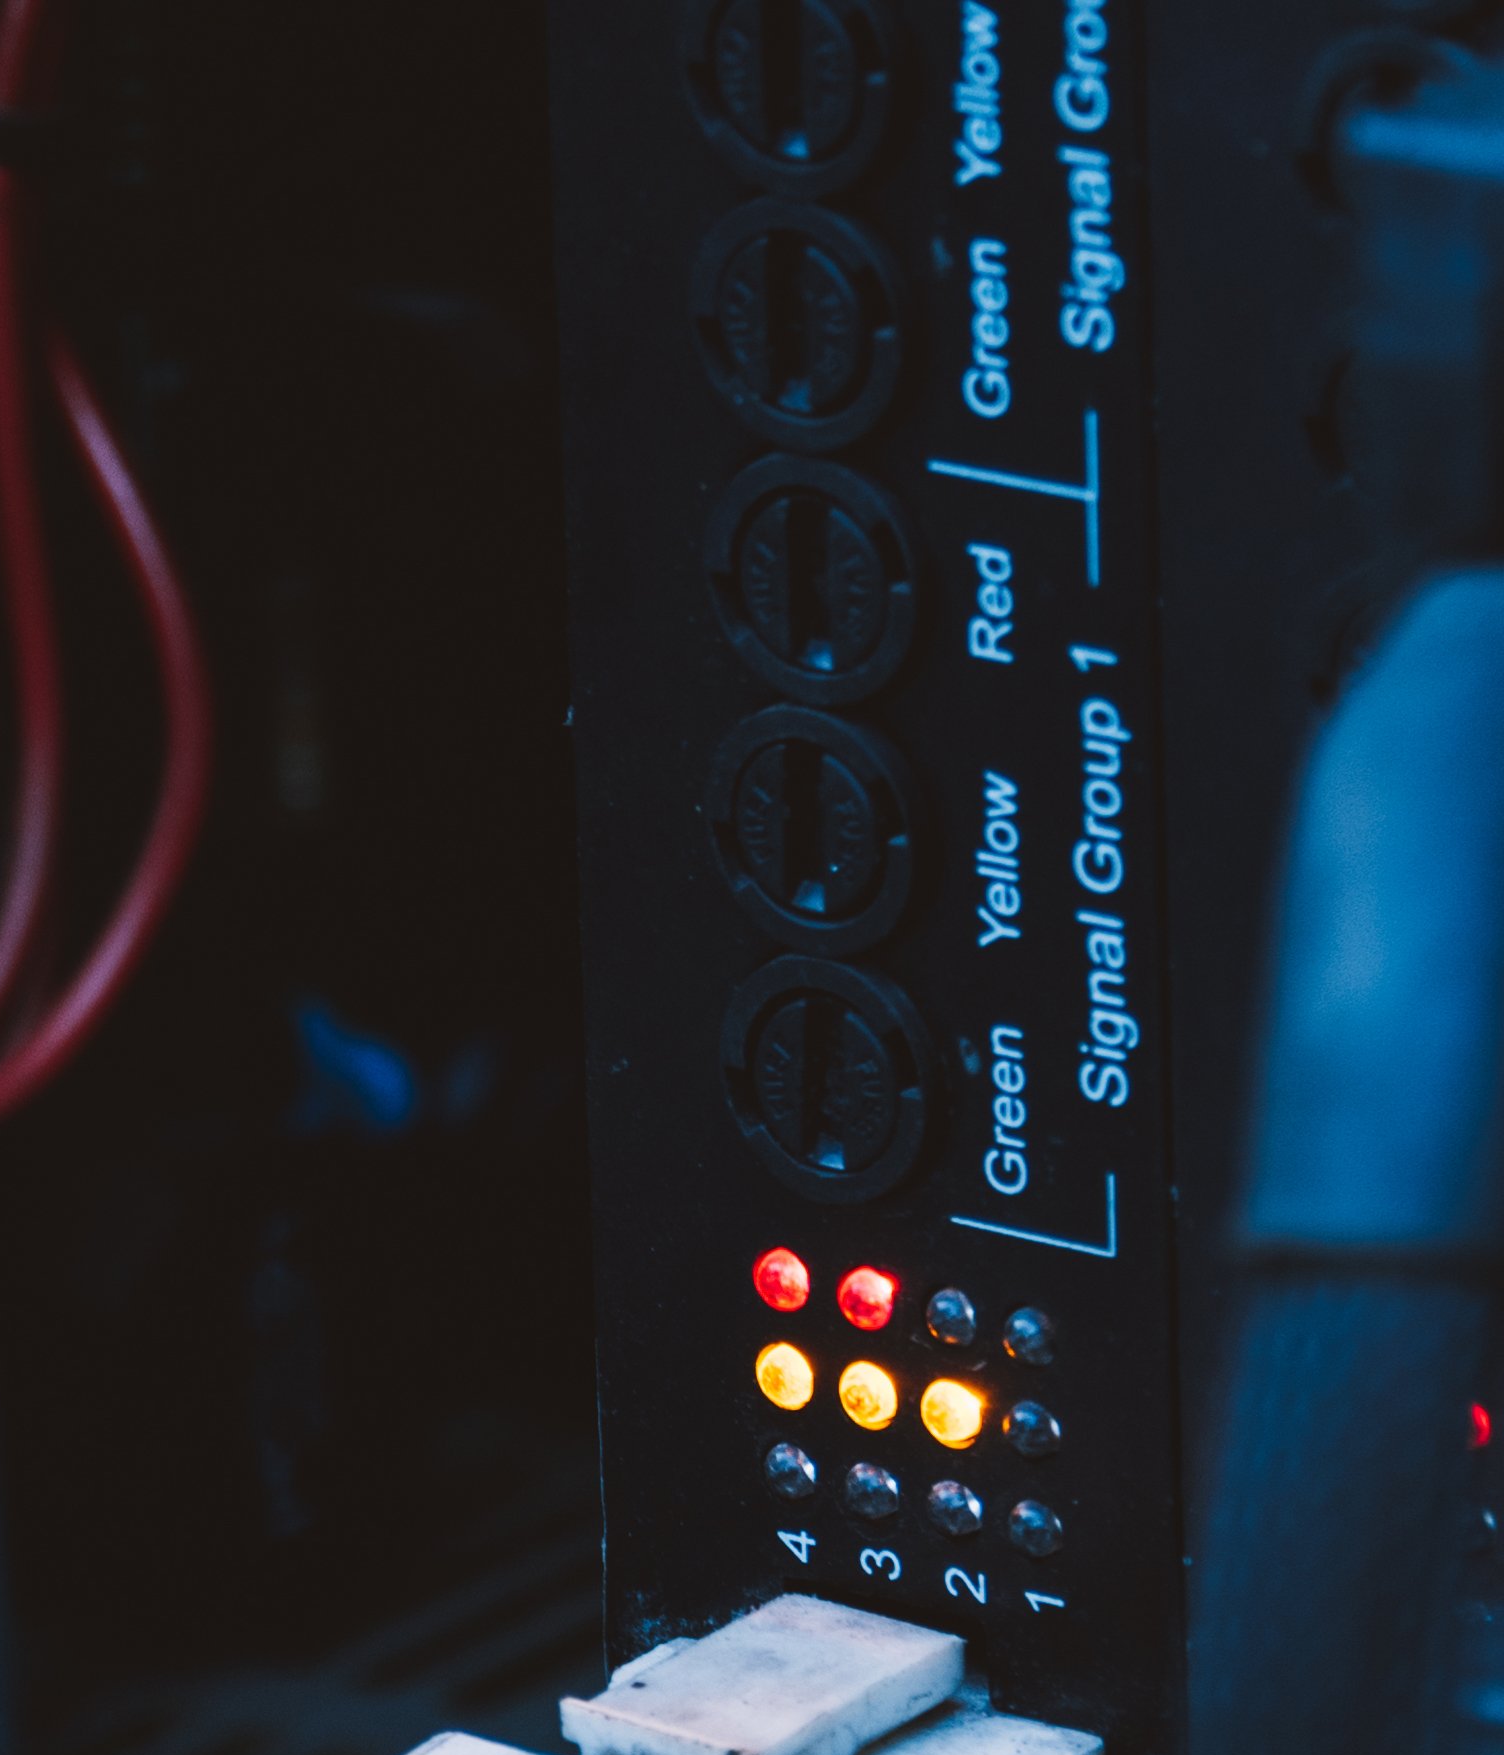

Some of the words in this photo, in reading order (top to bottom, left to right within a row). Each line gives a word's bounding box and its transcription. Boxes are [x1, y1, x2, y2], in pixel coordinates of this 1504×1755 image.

[951, 0, 1005, 188] Yellow
[1051, 0, 1112, 135] Gro
[1055, 142, 1128, 355] Signal
[959, 235, 1014, 421] Green
[964, 540, 1016, 666] Red
[1066, 642, 1120, 674] 1
[973, 768, 1024, 949] Yellow
[1070, 694, 1134, 896] Group
[1073, 907, 1142, 1109] Signal
[981, 1022, 1031, 1197] Green
[775, 1528, 818, 1565] 4
[858, 1545, 904, 1583] 3
[942, 1564, 989, 1606] 2
[1022, 1588, 1067, 1614] 1
